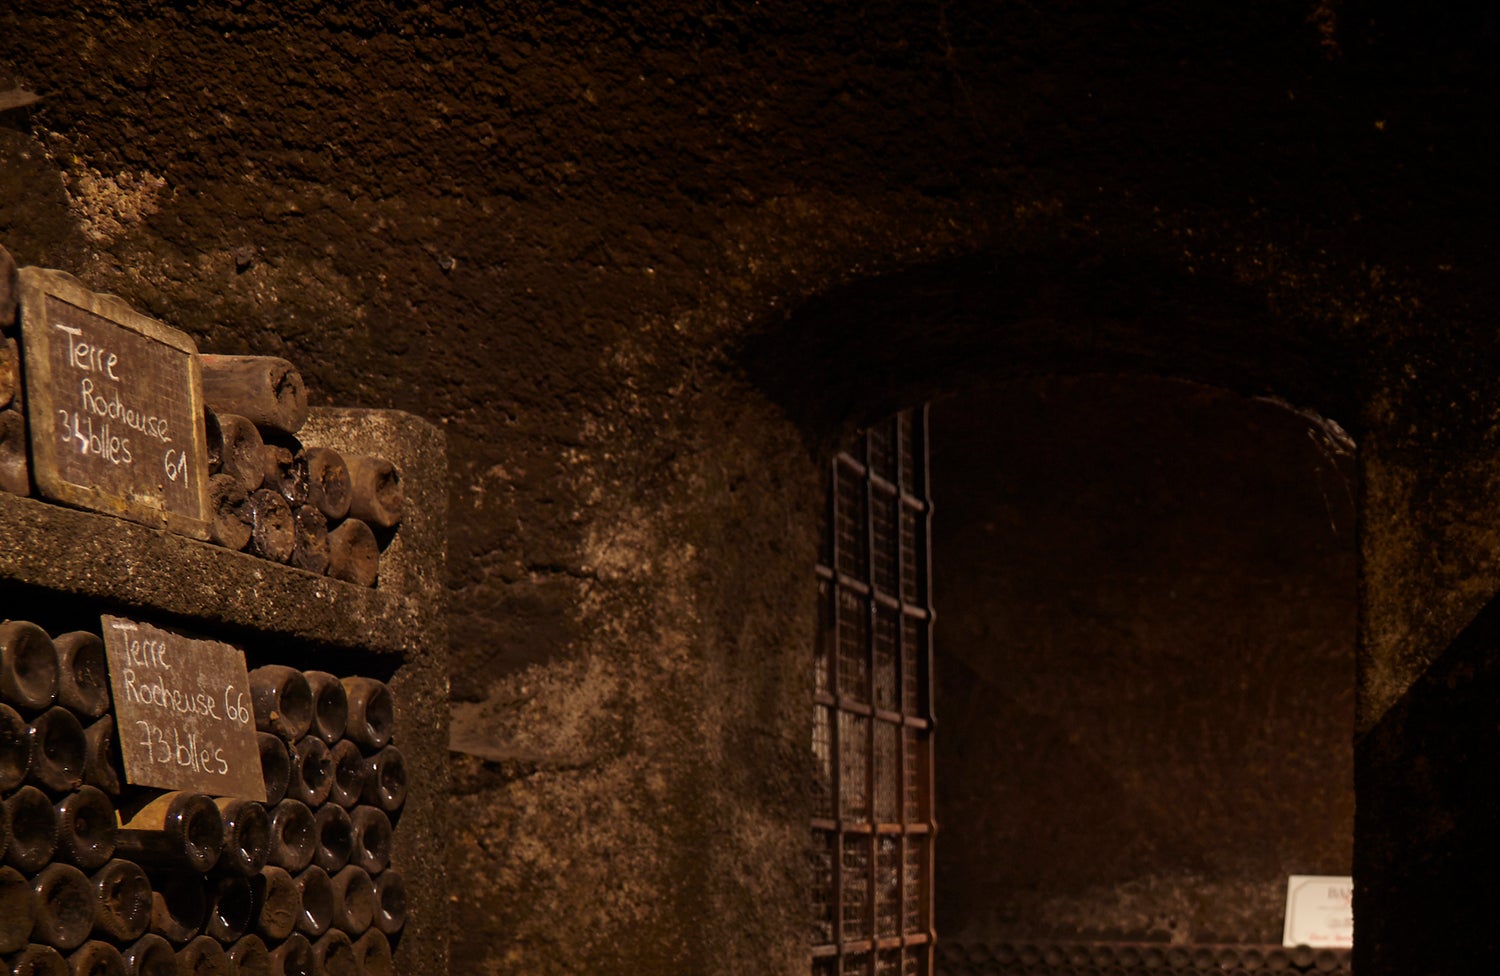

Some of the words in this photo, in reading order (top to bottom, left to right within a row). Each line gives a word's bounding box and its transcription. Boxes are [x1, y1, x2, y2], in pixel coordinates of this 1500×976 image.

[55, 324, 119, 381] Terre
[81, 378, 173, 442] Rocheuse
[163, 449, 189, 488] 61
[112, 623, 171, 669] Terre
[122, 668, 222, 720] Rocheuse
[224, 684, 249, 724] 66
[136, 720, 172, 764] 73
